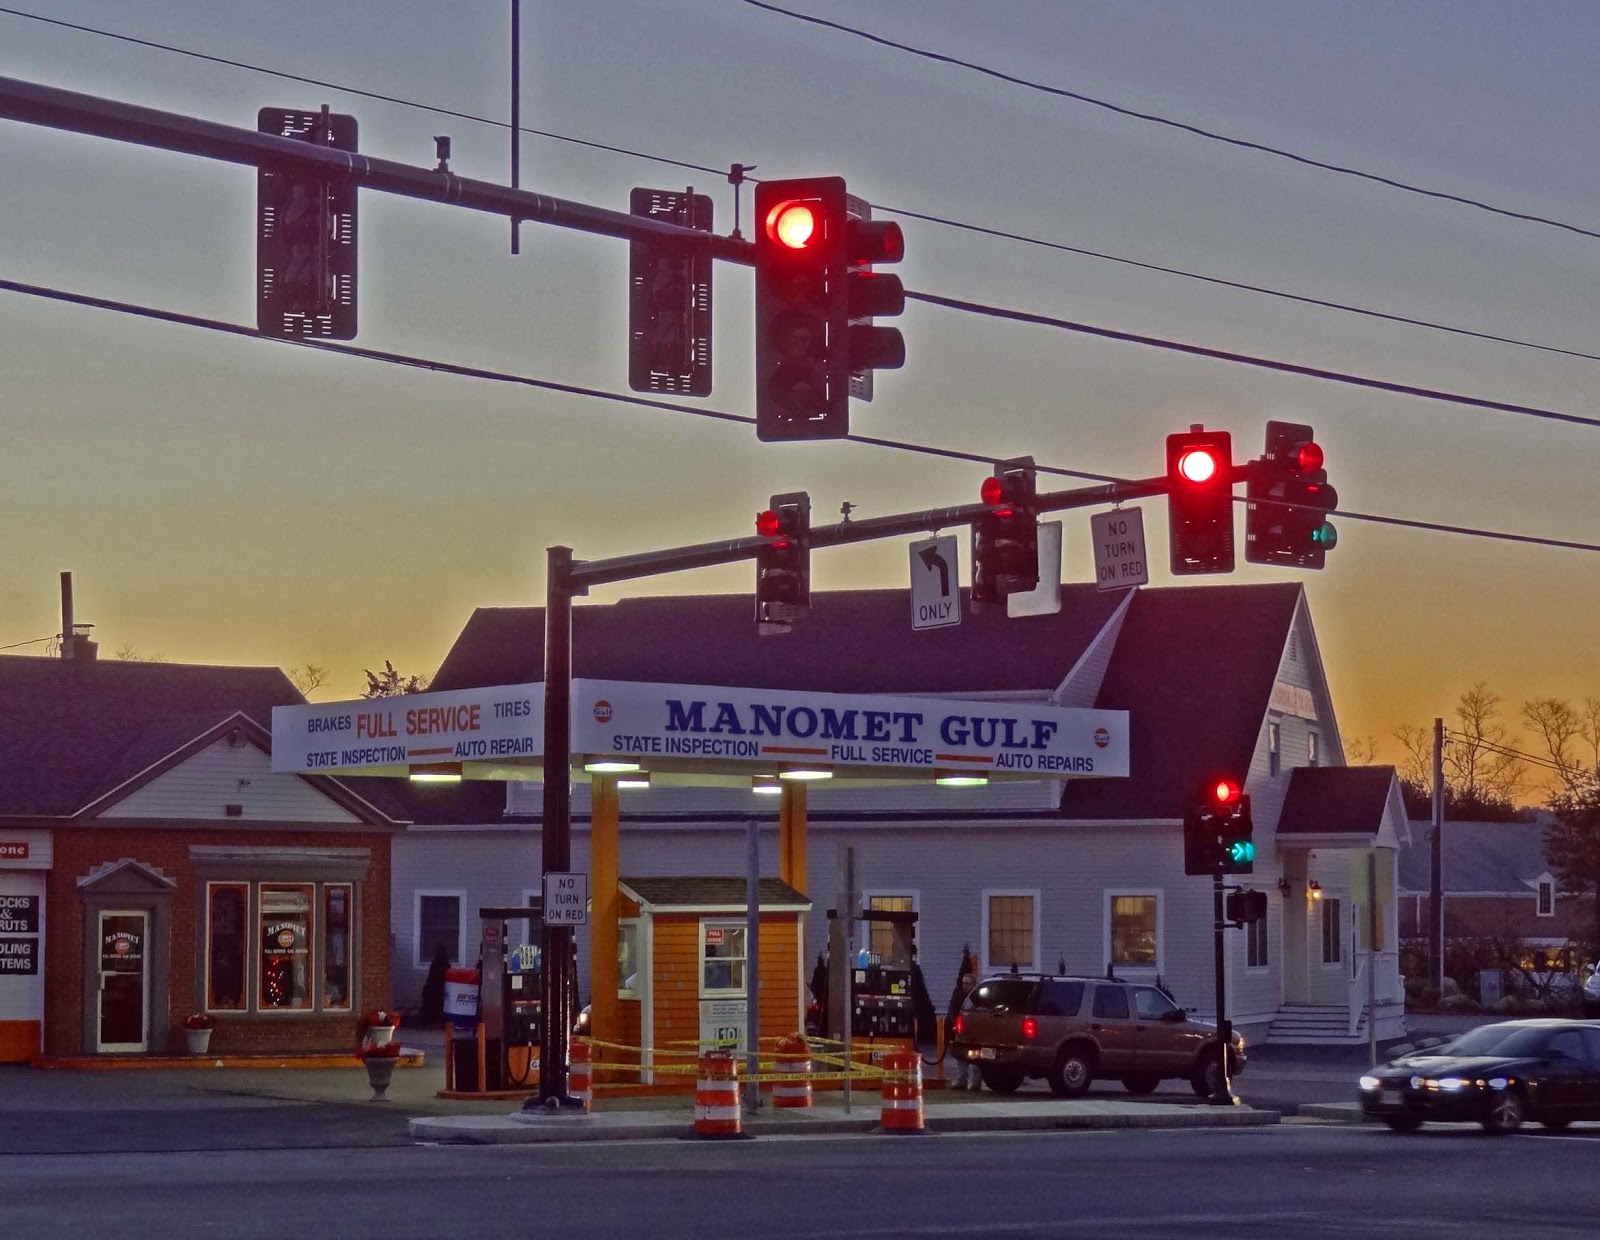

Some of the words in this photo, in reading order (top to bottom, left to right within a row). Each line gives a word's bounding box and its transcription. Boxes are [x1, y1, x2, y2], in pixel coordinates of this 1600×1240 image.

[1108, 520, 1128, 536] NO
[1104, 540, 1135, 559] TURN
[1100, 565, 1116, 581] ON
[1121, 561, 1143, 578] RED
[919, 601, 953, 621] ONLY
[307, 715, 352, 733] BRAKES
[356, 712, 398, 739] FULL
[405, 703, 481, 735] SERVICE
[494, 700, 531, 718] TIRES
[665, 699, 923, 742] MANOMET
[940, 715, 1058, 749] GULF
[455, 740, 487, 757] AUTO
[490, 737, 534, 755] REPAIR
[613, 734, 661, 752] STATE
[665, 737, 759, 756] INSPECTION
[831, 744, 867, 762] FULL
[872, 746, 933, 764] SERVICE
[306, 750, 339, 768] STATE
[341, 745, 406, 766] INSPECTION
[996, 752, 1033, 769] AUTO
[1038, 755, 1094, 772] REPAIRS
[0, 845, 25, 855] one
[558, 878, 575, 889] NO
[554, 894, 579, 905] TURN
[0, 908, 13, 919] &
[549, 909, 562, 920] ON
[565, 910, 584, 920] RED
